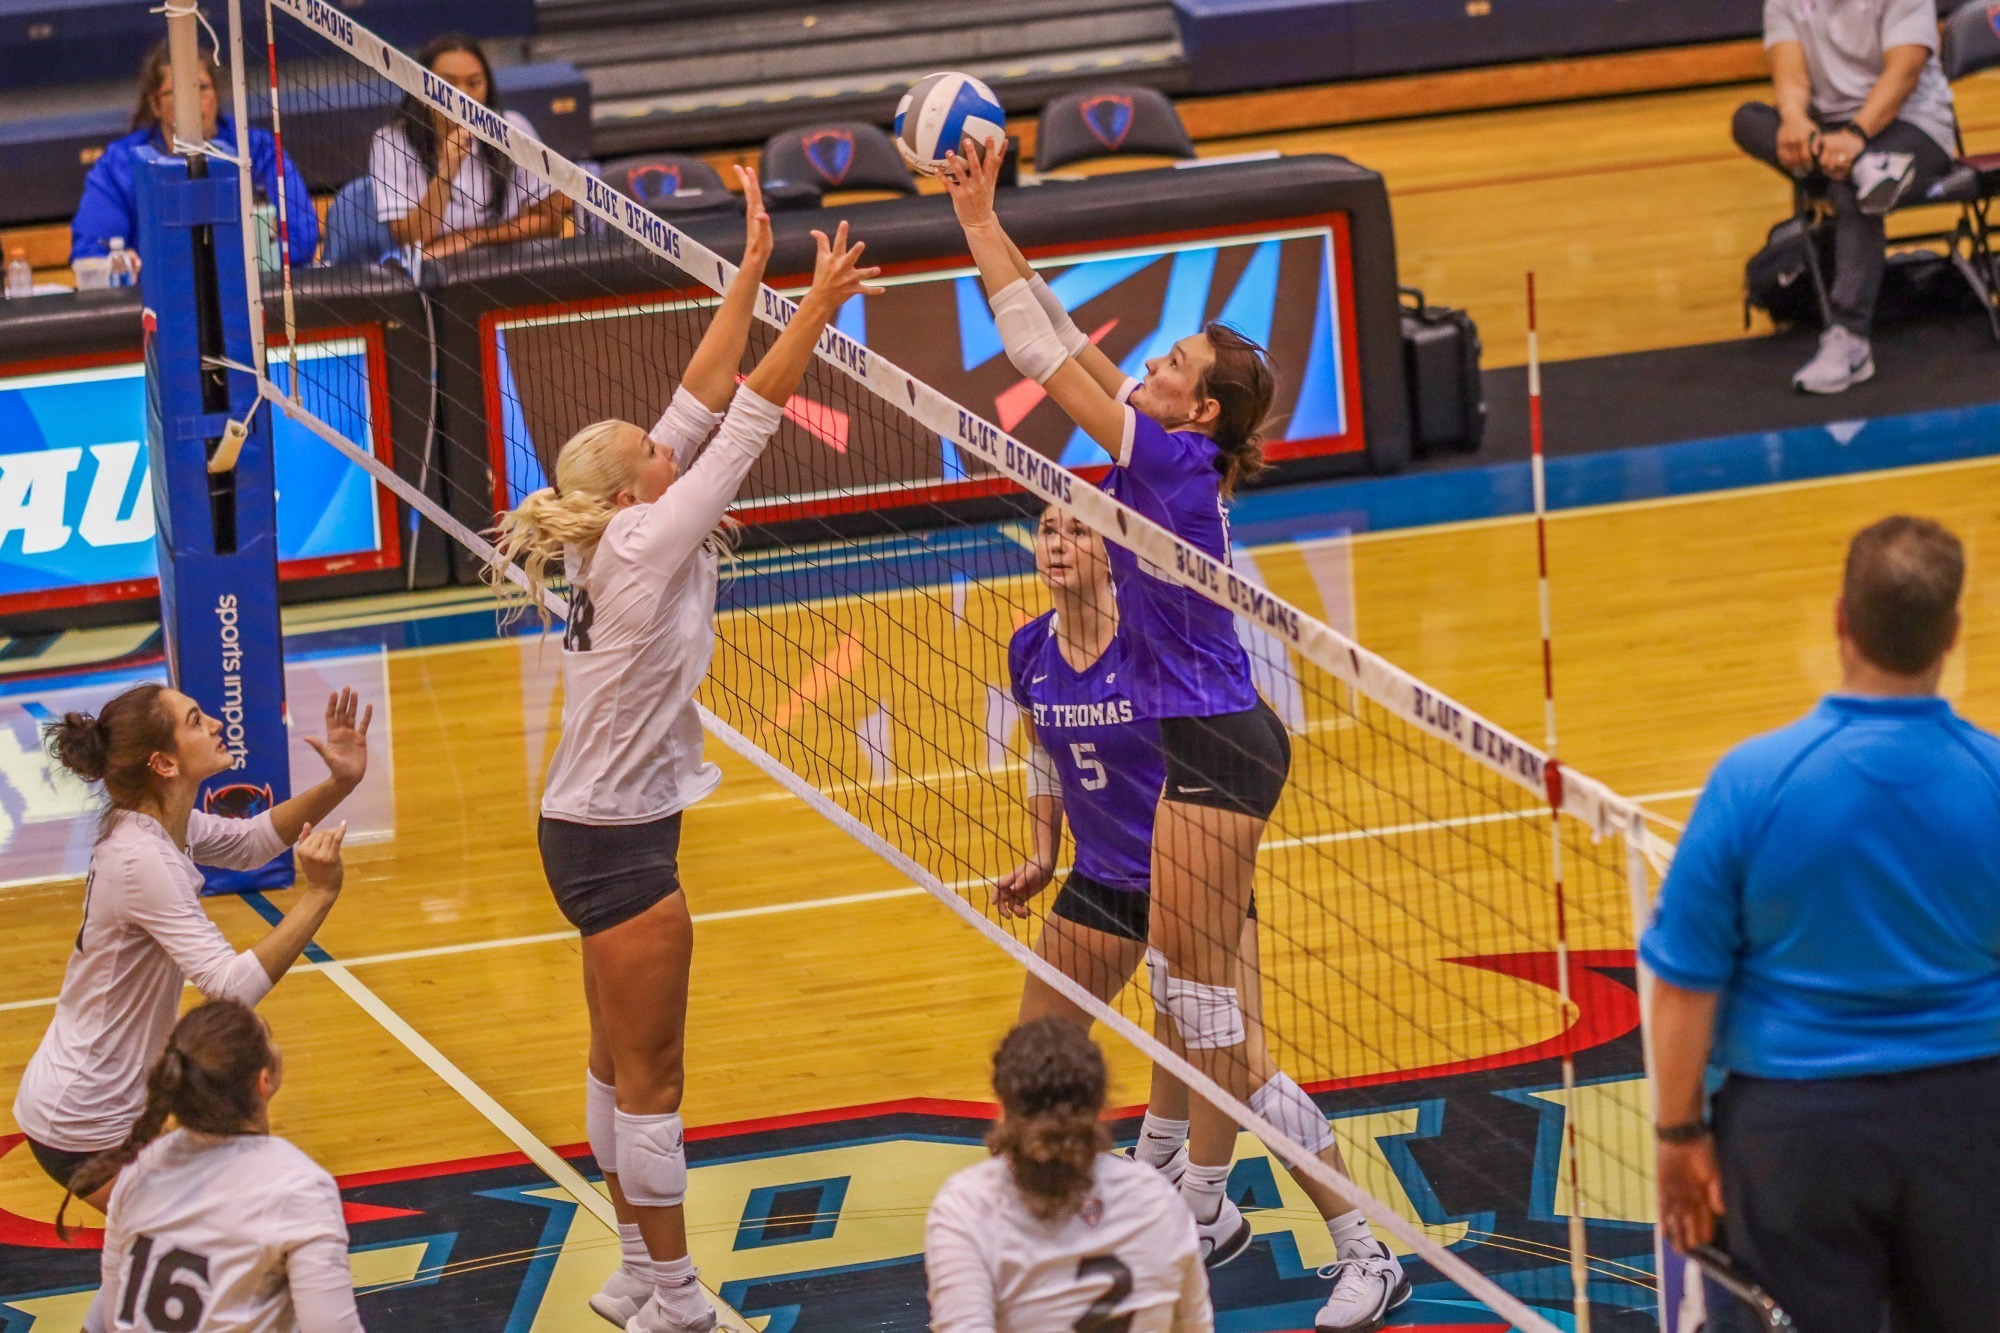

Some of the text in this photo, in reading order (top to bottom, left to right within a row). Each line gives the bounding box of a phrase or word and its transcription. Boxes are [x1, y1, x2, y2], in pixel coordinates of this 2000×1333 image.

[306, 0, 353, 46] DEMONS
[586, 176, 681, 259] BLUE DEMONS
[764, 289, 797, 326] BLU
[958, 410, 1072, 504] BLUE DEMONS
[1175, 543, 1299, 641] BLUE DEMONS
[215, 594, 243, 672] sports
[1052, 700, 1133, 728] THOMAS
[1069, 743, 1109, 791] 5
[118, 1233, 210, 1333] 16
[1072, 1254, 1133, 1333] 2
